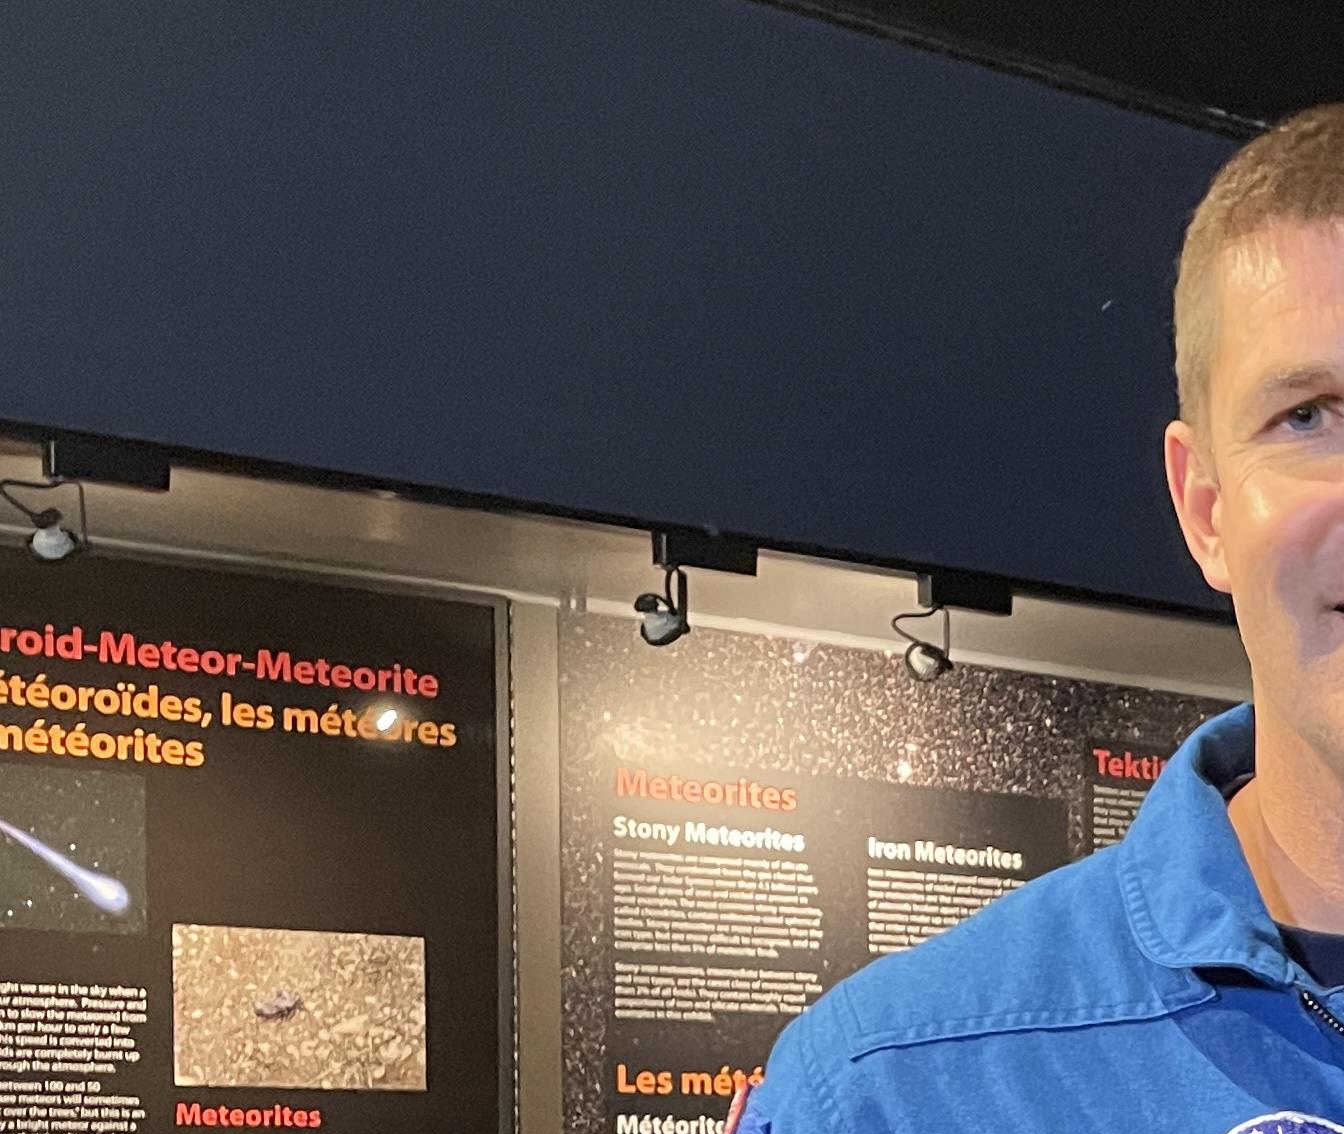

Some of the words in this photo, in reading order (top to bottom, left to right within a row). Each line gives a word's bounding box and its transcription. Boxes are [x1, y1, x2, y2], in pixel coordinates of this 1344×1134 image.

[221, 692, 275, 729] les
[615, 767, 798, 811] Meteorites
[613, 816, 681, 846] Stony
[684, 821, 805, 852] Meteorites
[868, 836, 911, 861] Iron
[914, 840, 1023, 870] Meteorites
[70, 984, 89, 996] the
[616, 1064, 673, 1095] Les
[175, 1103, 321, 1128] Meteorites
